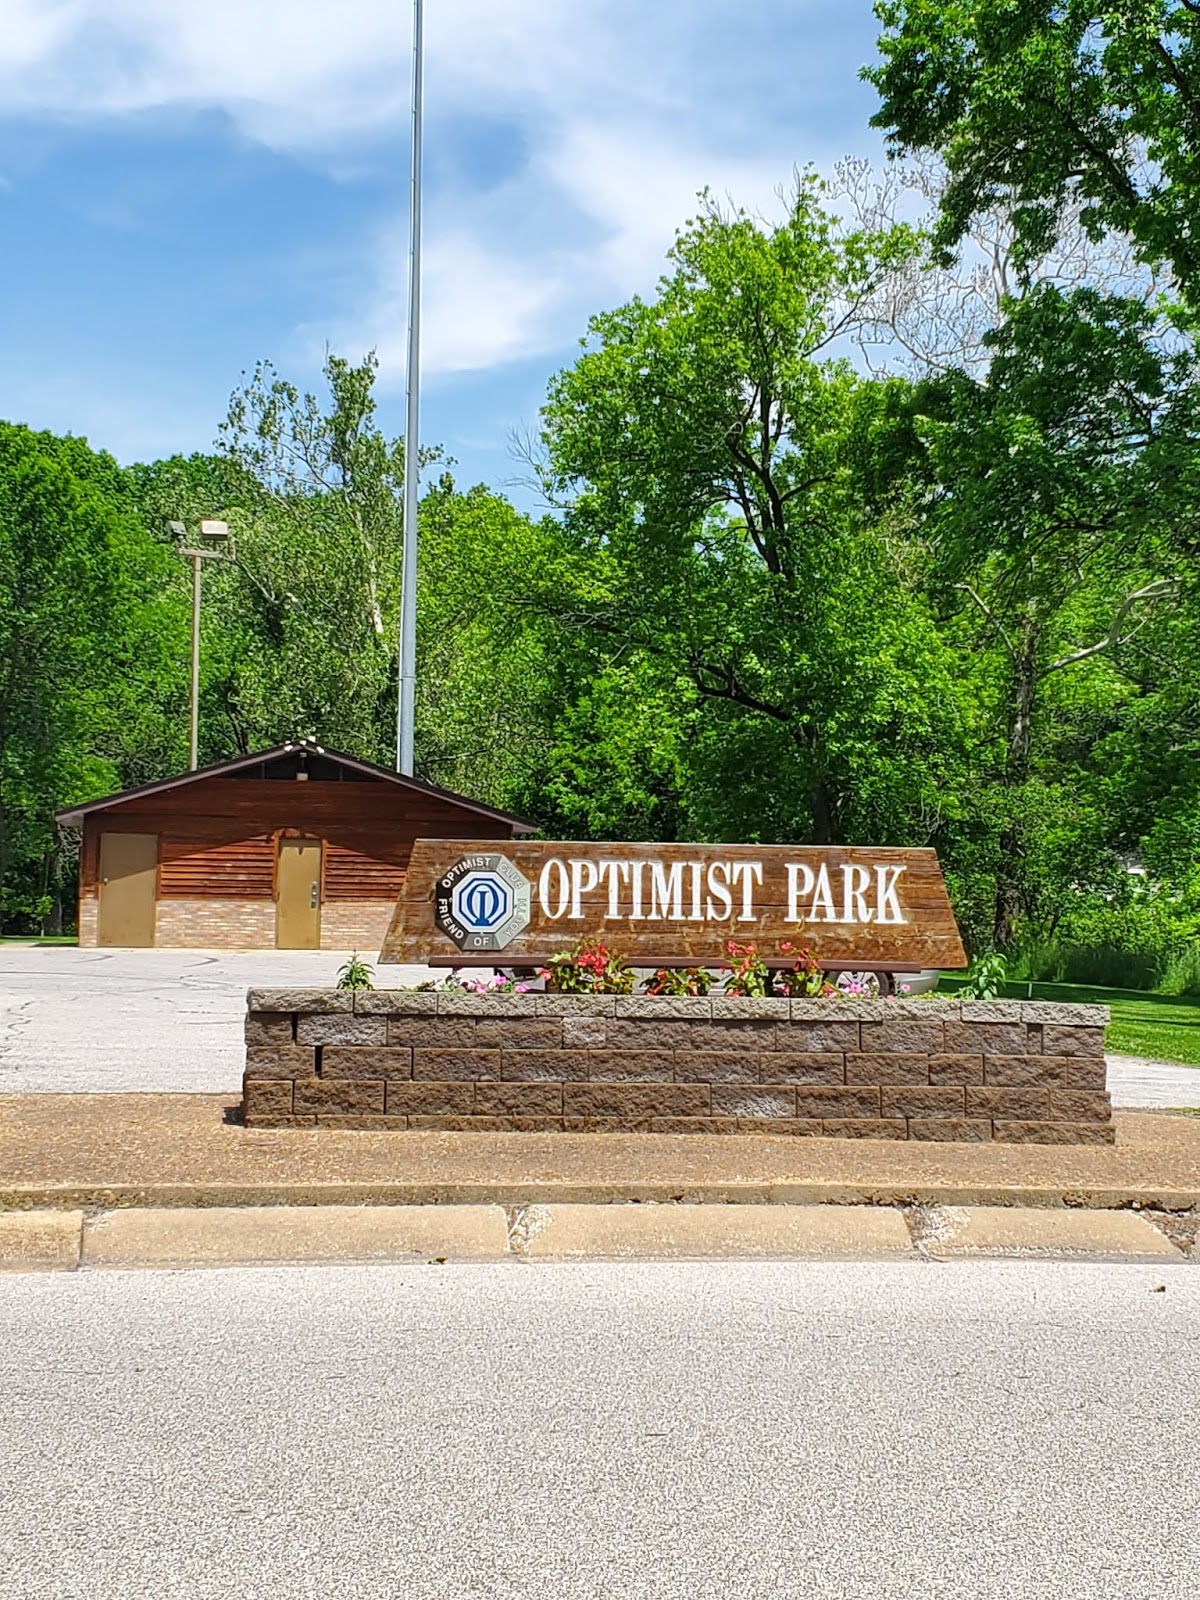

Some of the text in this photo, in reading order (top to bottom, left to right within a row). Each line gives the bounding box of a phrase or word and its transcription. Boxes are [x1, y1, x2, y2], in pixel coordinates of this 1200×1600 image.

[441, 857, 525, 889] OPTIMIST CLUB
[538, 858, 909, 924] OPTIMIST PARK
[438, 898, 527, 946] FRIEND OF YOUTH
